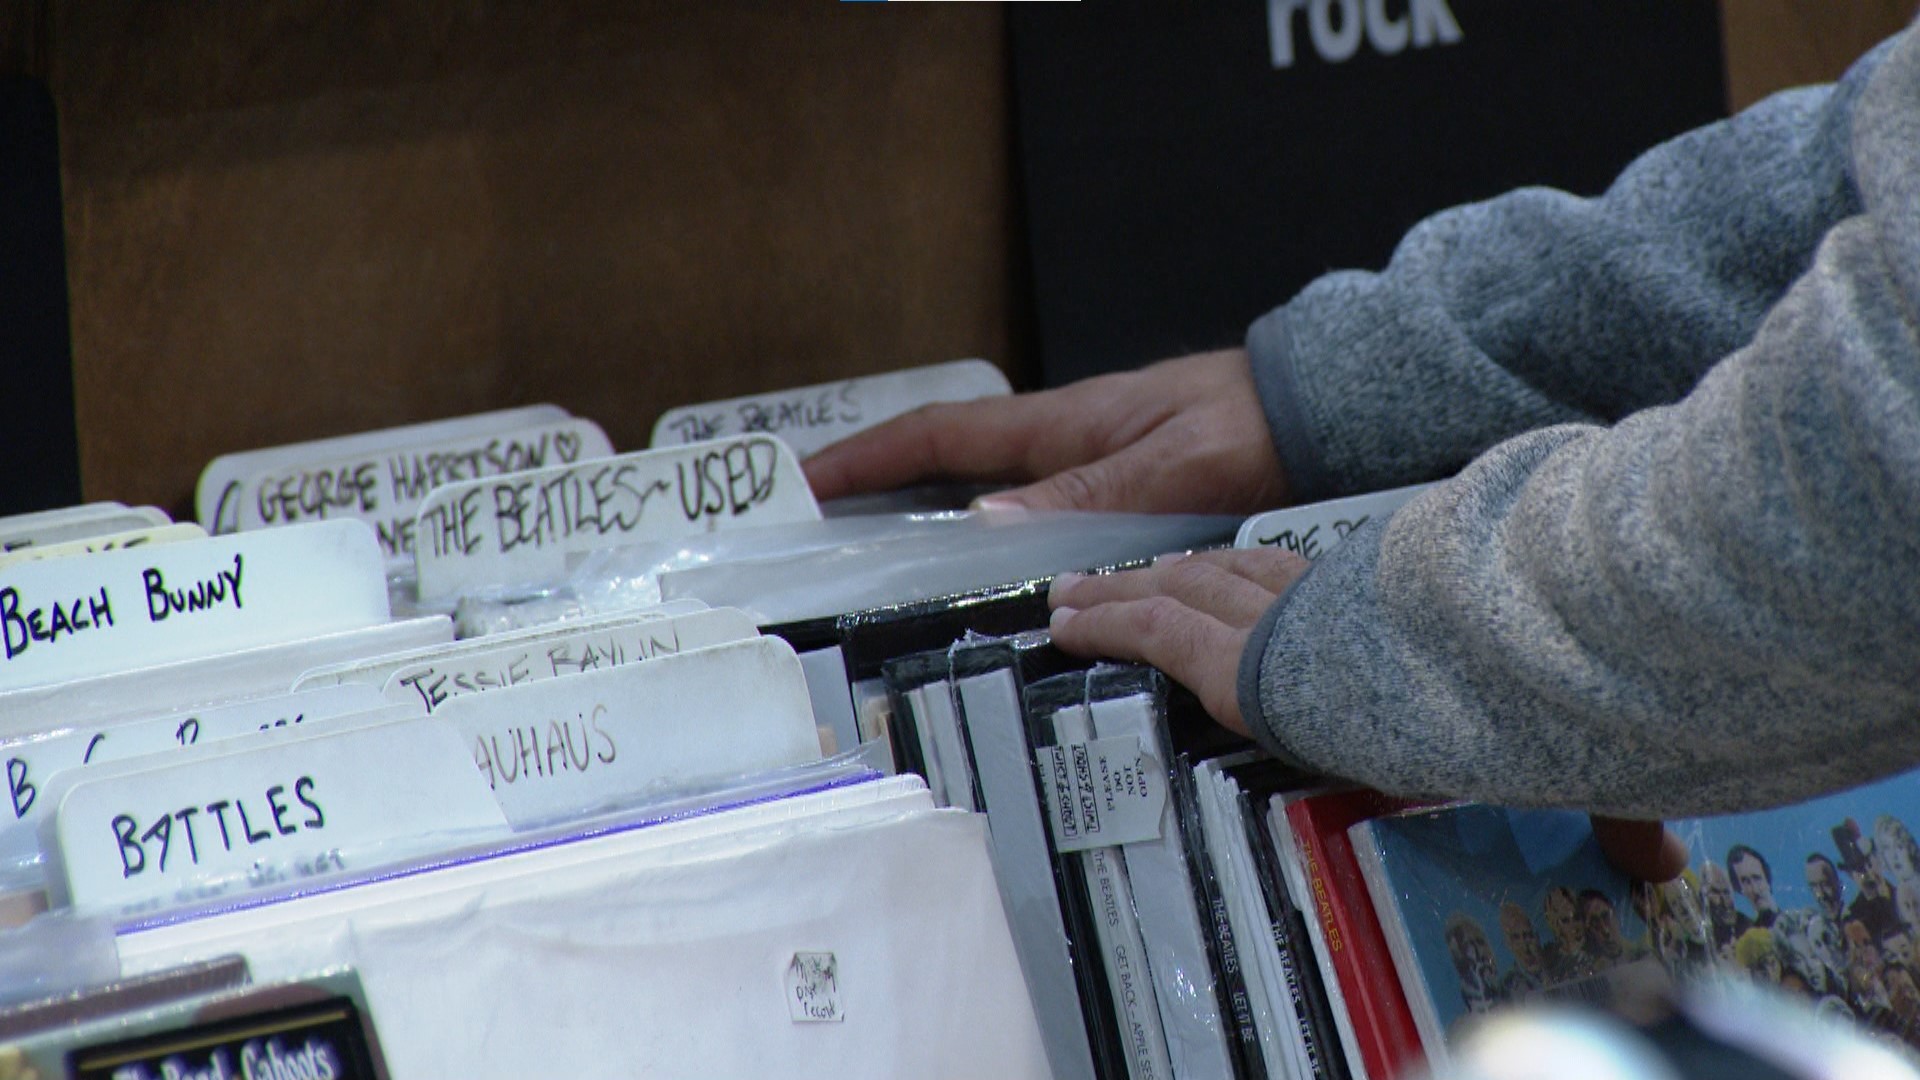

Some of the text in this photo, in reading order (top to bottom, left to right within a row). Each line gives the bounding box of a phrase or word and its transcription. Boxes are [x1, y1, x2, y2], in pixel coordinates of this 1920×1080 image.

[738, 384, 860, 433] BEATLES
[422, 487, 483, 558] THE
[495, 464, 643, 552] BEATLES
[677, 439, 777, 522] USED
[0, 553, 242, 660] BEACH BUNNY
[475, 703, 616, 792] AUHAUS
[1099, 755, 1115, 811] PLEASE
[1113, 770, 1123, 792] DO
[1123, 764, 1136, 796] NOT
[1134, 757, 1148, 798] OPEN
[111, 776, 325, 879] BATTLES
[1092, 850, 1108, 875] THE
[1100, 877, 1119, 928] BEATLES
[1302, 841, 1342, 952] THE BEATLES
[1115, 944, 1129, 969] GET
[1217, 922, 1239, 975] BEATLES
[1271, 920, 1286, 946] THE
[1280, 950, 1301, 1004] BEATLES
[1121, 971, 1138, 1008] BACK
[1132, 1021, 1149, 1055] APPLE
